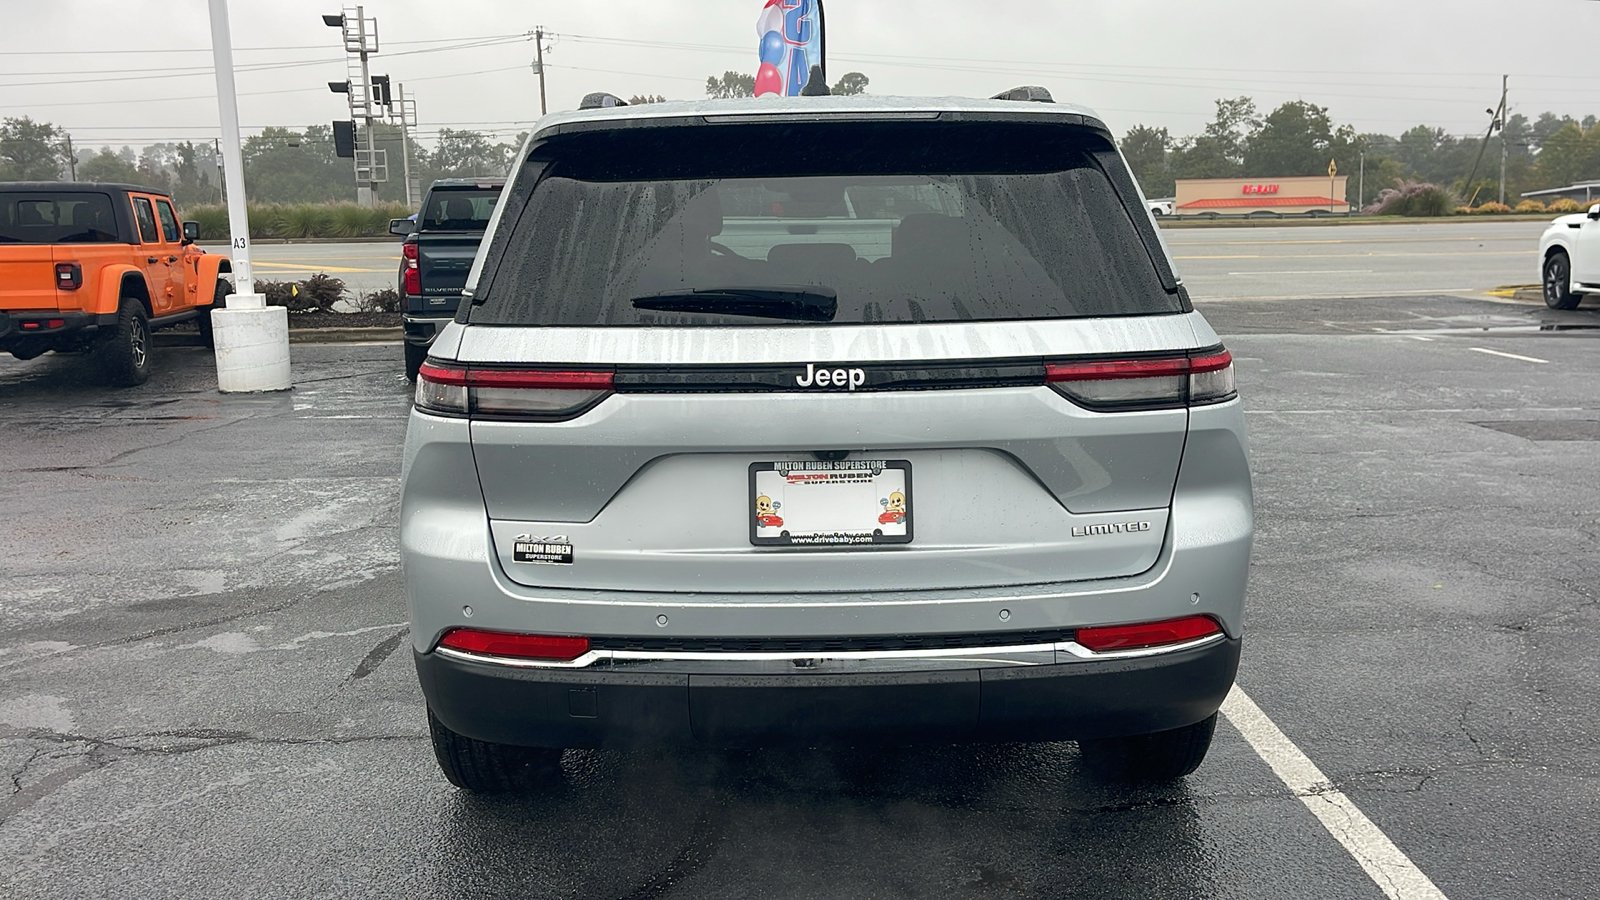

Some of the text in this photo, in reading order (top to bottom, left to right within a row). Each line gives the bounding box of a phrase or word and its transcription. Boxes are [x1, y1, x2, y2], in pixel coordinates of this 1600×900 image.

[234, 238, 246, 249] A3
[796, 363, 866, 391] Jeep
[774, 460, 887, 471] MILTON RUBEN SUPERSTORE
[1071, 521, 1151, 537] LIMITED
[516, 543, 571, 555] MILTON RUBEN
